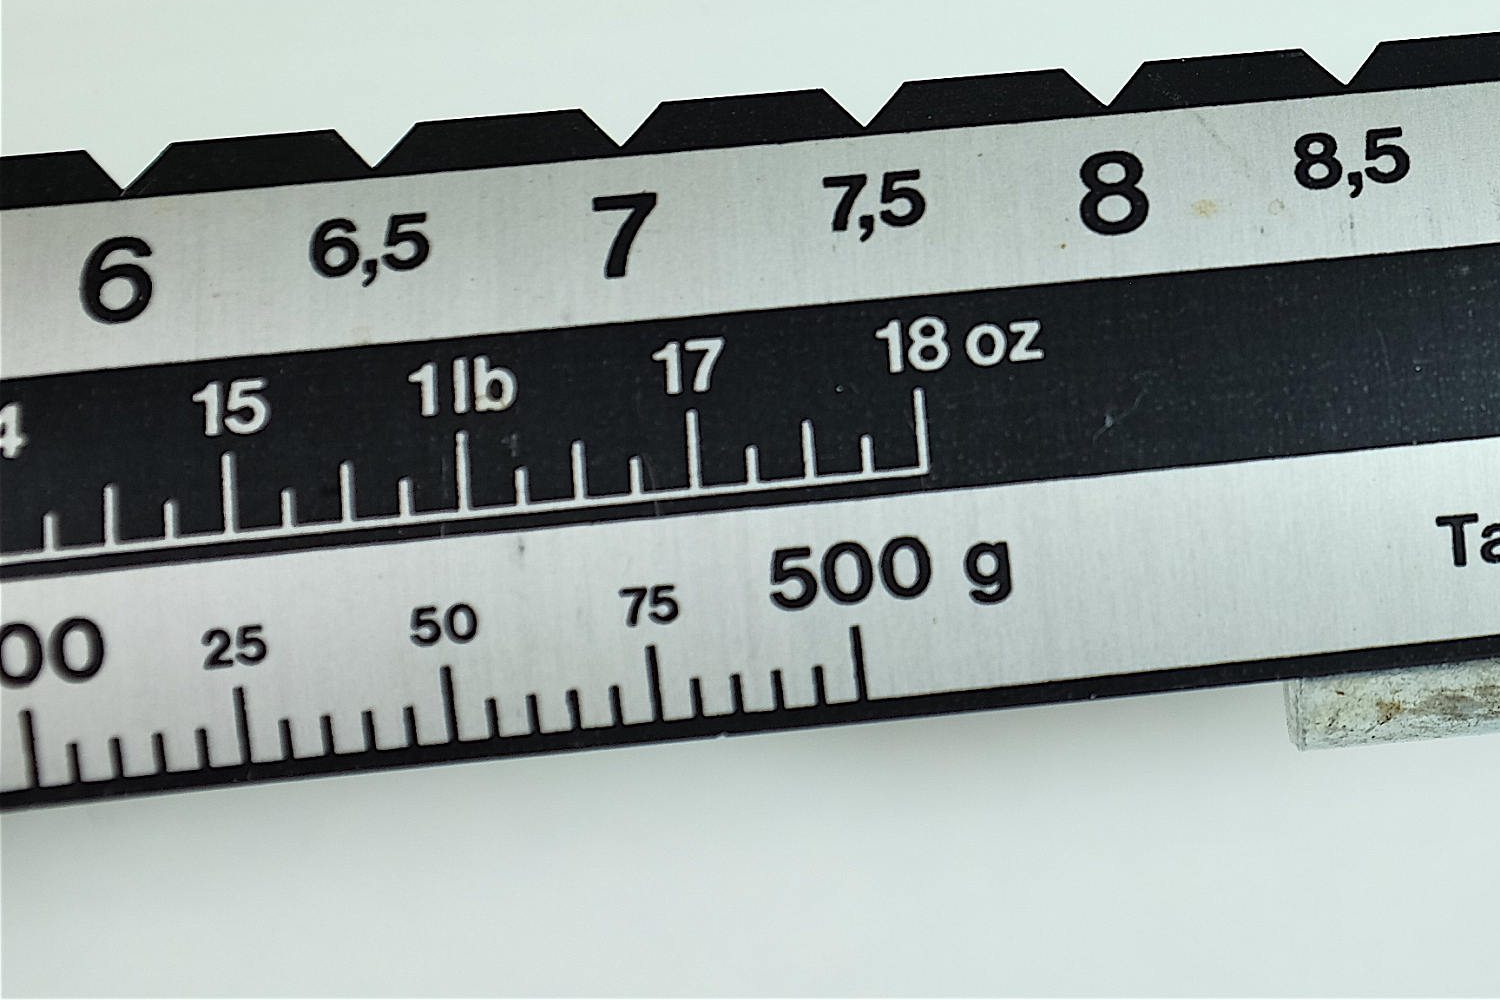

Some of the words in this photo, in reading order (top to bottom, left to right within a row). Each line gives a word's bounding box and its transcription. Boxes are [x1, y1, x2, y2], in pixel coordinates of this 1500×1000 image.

[79, 235, 153, 325] 6
[309, 211, 431, 288] 6,5
[591, 190, 658, 280] 7
[822, 168, 927, 243] 7,5
[1079, 150, 1150, 237] 8
[1293, 126, 1411, 199] 8,5
[192, 379, 269, 436] 15
[652, 337, 725, 395] 17
[875, 316, 949, 373] 18
[965, 320, 1045, 367] oz
[201, 623, 268, 671] 25
[409, 602, 479, 648] 50
[618, 583, 680, 628] 75
[769, 535, 933, 612] 500
[963, 541, 1013, 606] g
